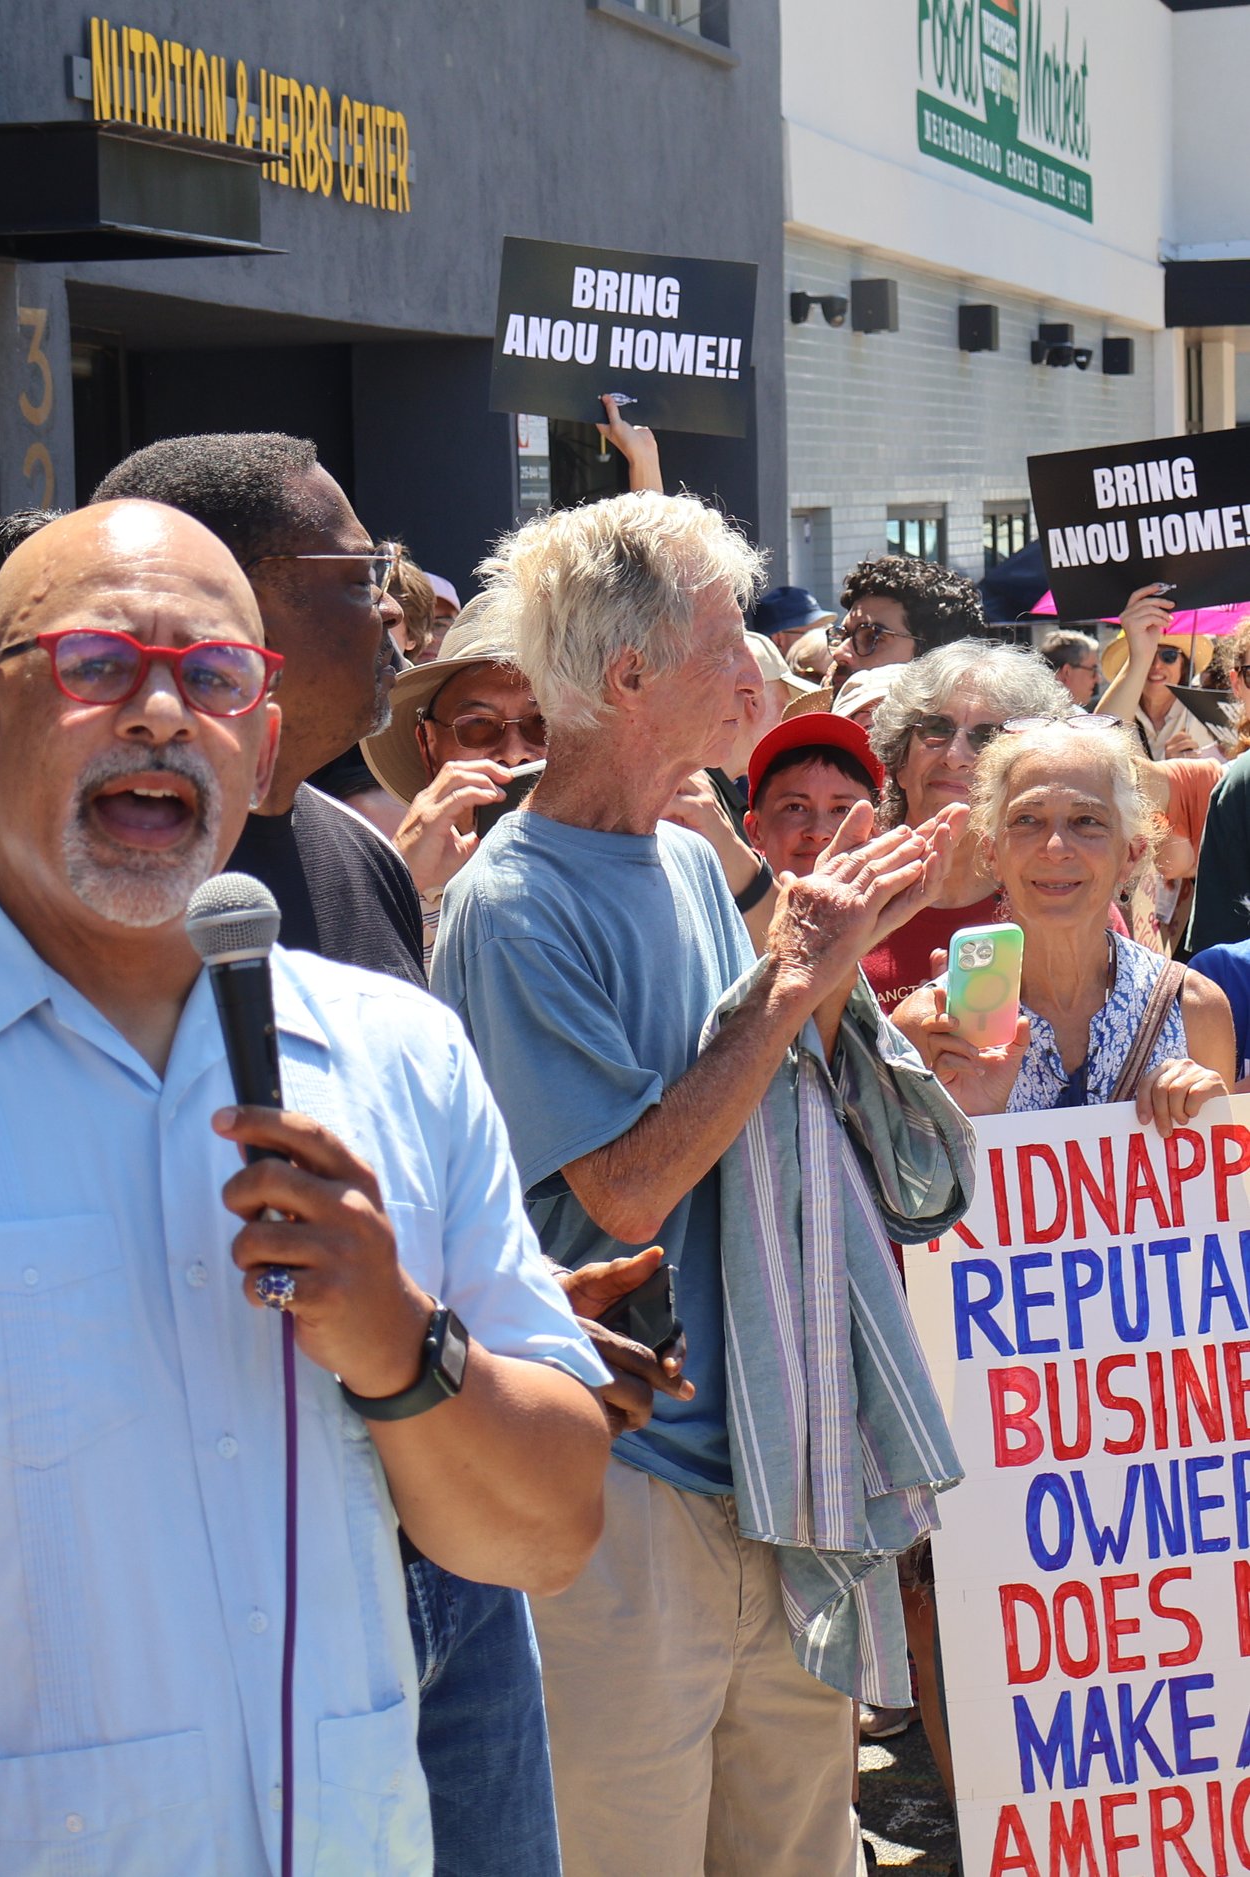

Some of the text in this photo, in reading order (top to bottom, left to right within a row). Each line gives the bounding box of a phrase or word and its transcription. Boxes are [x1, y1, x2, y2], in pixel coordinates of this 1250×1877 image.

[91, 16, 228, 144] NUTRITION
[259, 68, 334, 198] HERBS
[338, 94, 411, 213] CENTER
[502, 313, 742, 380] ANOU HOME!!
[571, 266, 681, 319] BRING
[1092, 456, 1198, 509] BRING
[1048, 519, 1130, 568] ANOU
[927, 1124, 1250, 1253] IDNAPP
[951, 1230, 1250, 1360] REPUTA
[998, 1566, 1203, 1685] DOES
[1013, 1673, 1219, 1794] MAKE
